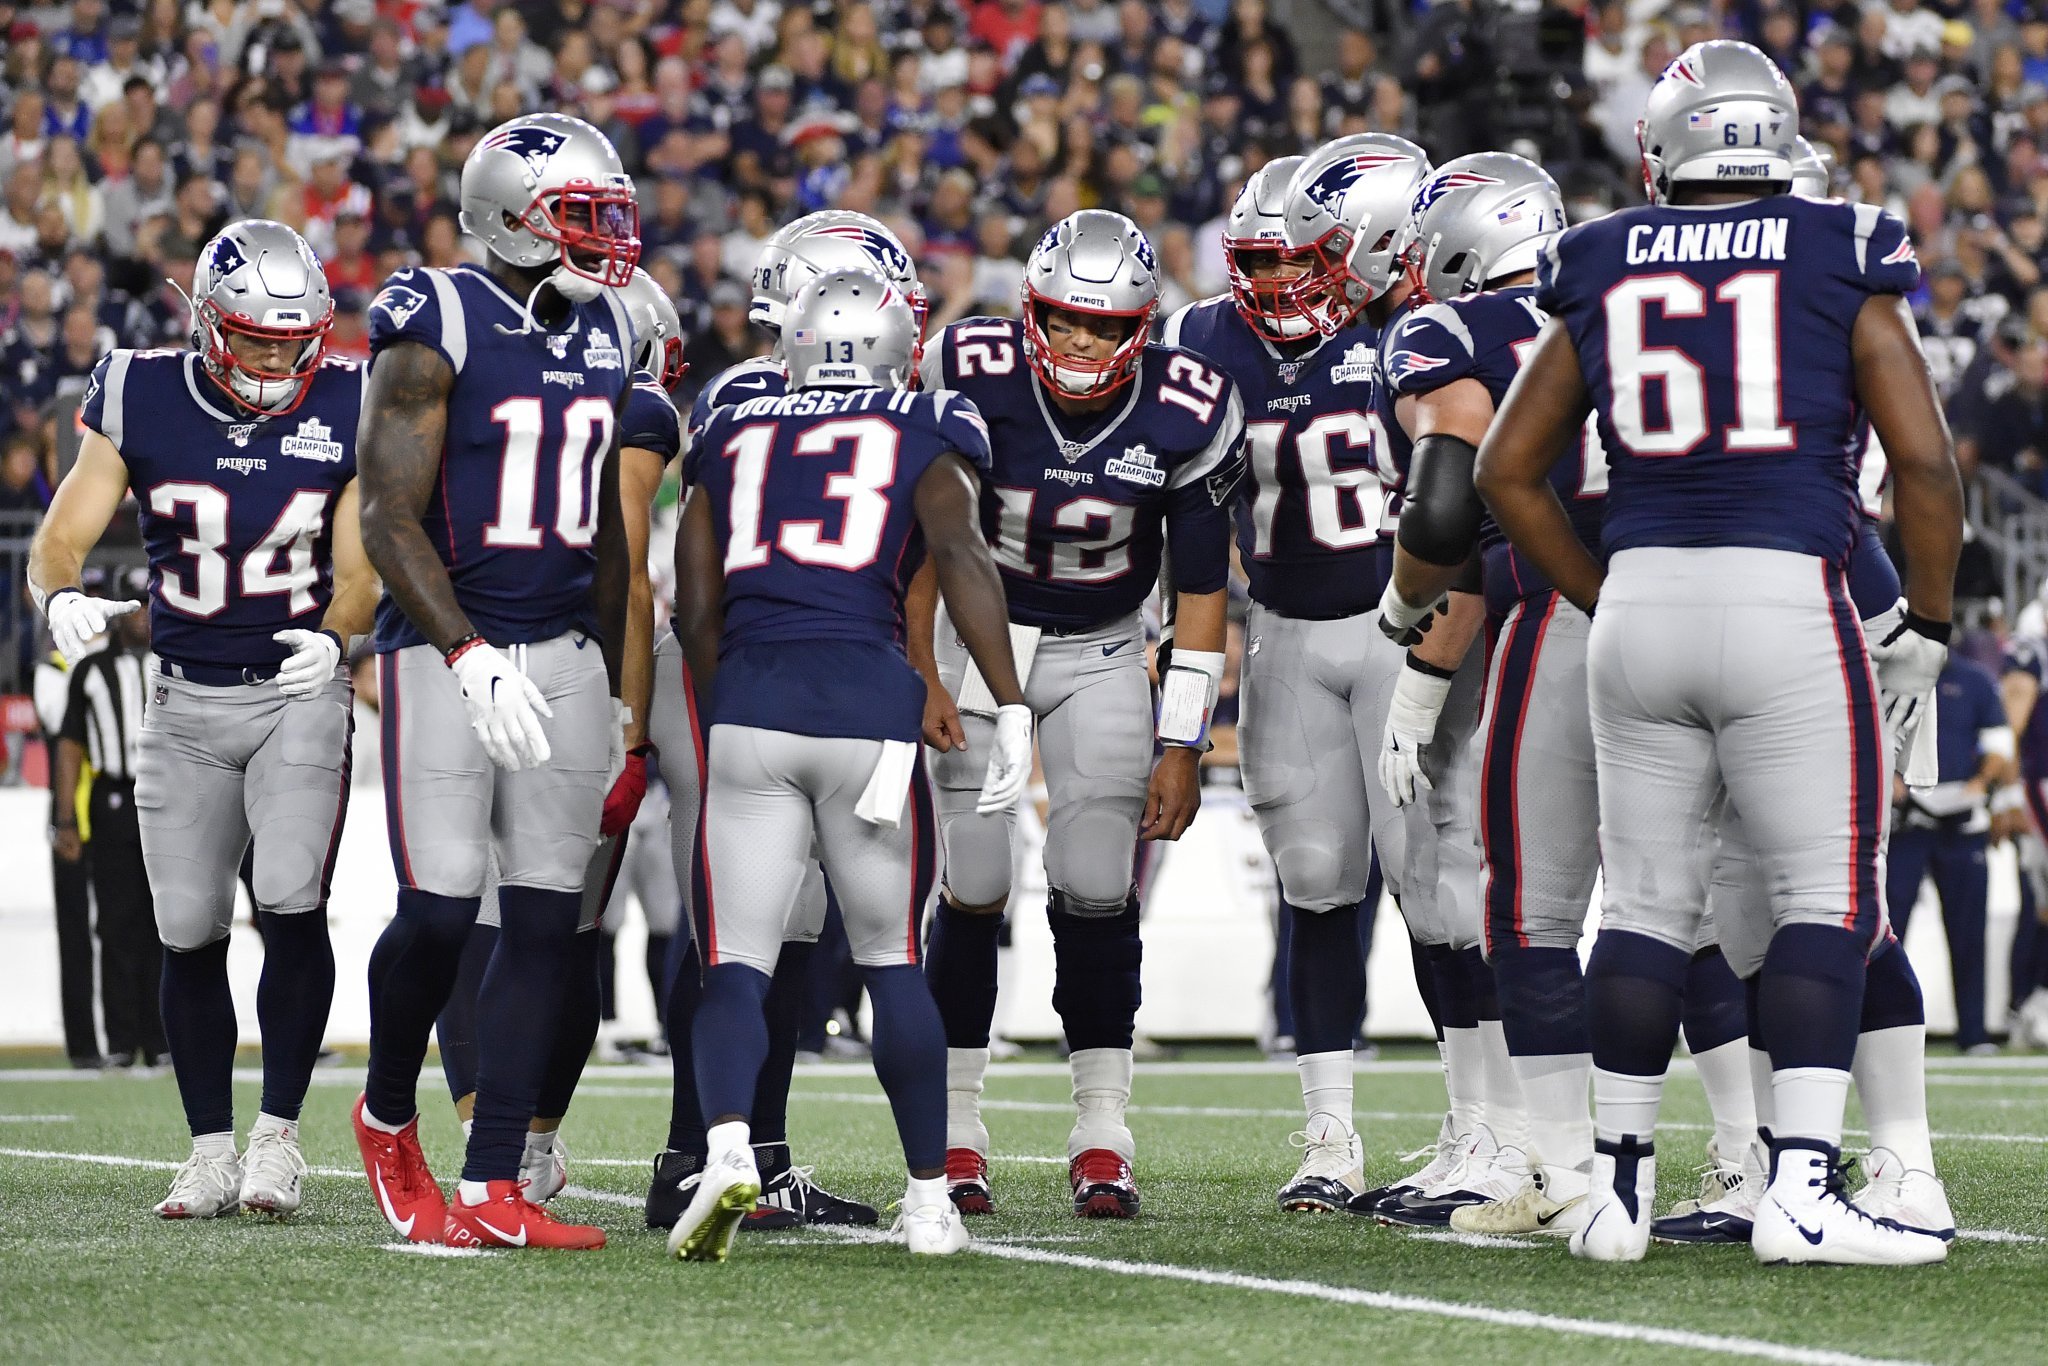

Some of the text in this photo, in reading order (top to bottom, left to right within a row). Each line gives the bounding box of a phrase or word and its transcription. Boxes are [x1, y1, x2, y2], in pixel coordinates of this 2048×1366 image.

[1723, 123, 1761, 146] 61
[1717, 163, 1770, 177] PATRIOTS
[1260, 231, 1284, 240] PATRI
[1626, 217, 1789, 266] CANNON
[1069, 295, 1106, 307] PATRIOTS
[825, 341, 854, 363] 13
[954, 319, 1017, 379] 12
[819, 369, 856, 379] PATRIOTS
[1601, 269, 1798, 457] 61
[542, 371, 585, 387] PATRIOTS
[1158, 353, 1226, 426] 12
[732, 387, 918, 422] DORSETT II
[1267, 394, 1312, 412] PATRIOTS
[284, 439, 341, 458] CHAMPIONS
[216, 458, 267, 471] PATRIOTS
[482, 396, 616, 549] 10
[1107, 461, 1164, 485] CHAMPIONS
[1044, 468, 1094, 485] PATRIOTS
[1247, 408, 1386, 559] 76
[722, 414, 901, 576] 13
[989, 484, 1138, 584] 12
[148, 479, 332, 620] 34
